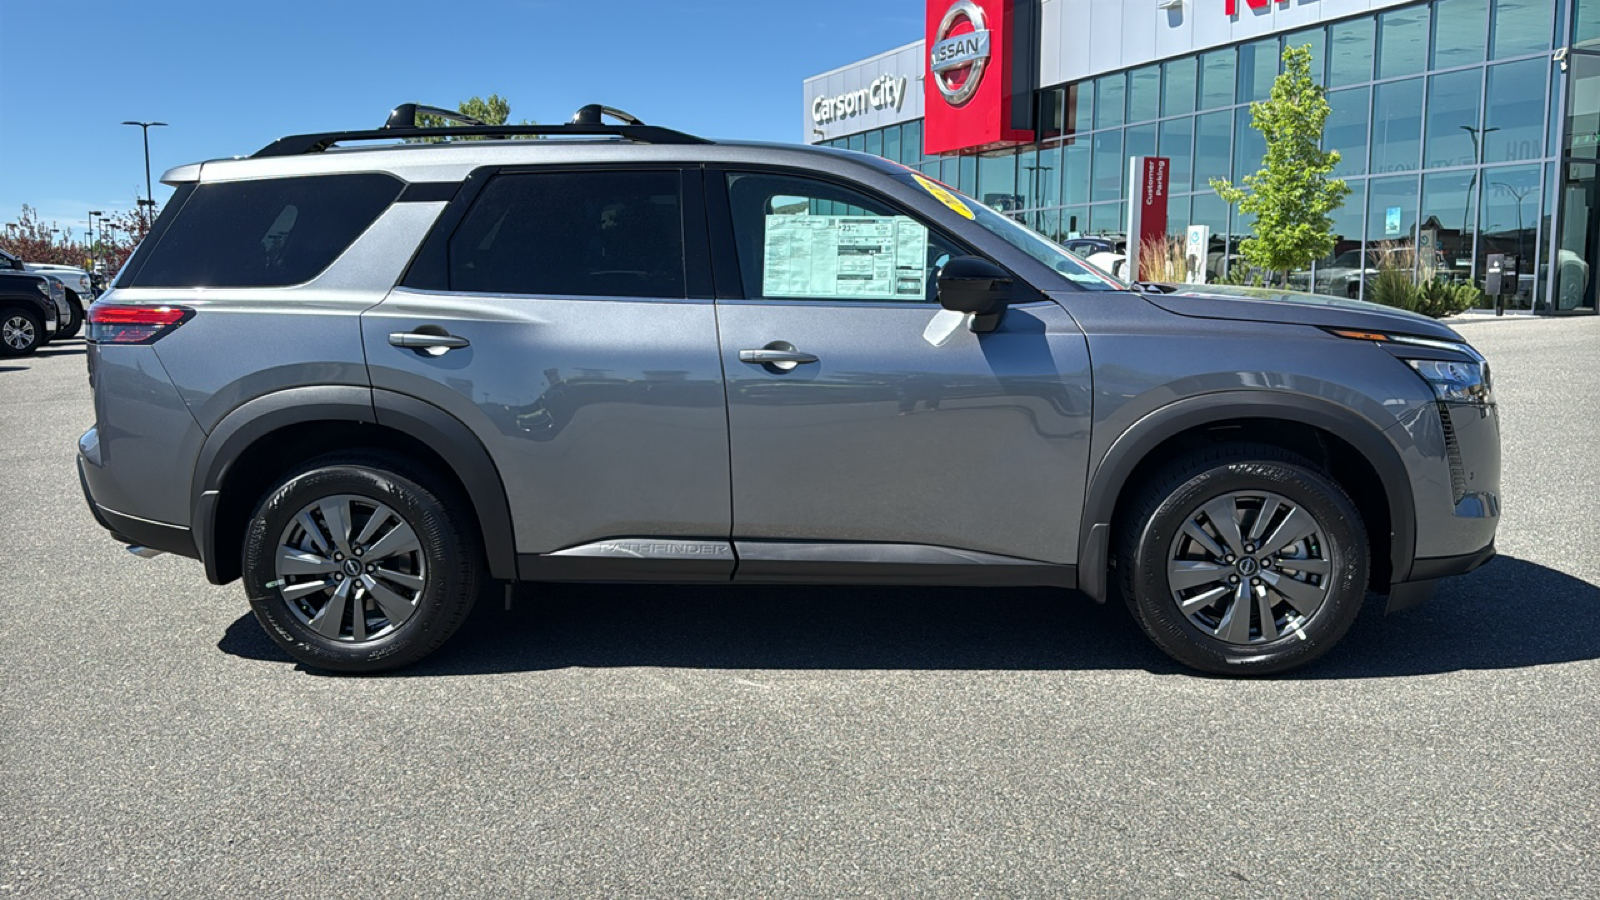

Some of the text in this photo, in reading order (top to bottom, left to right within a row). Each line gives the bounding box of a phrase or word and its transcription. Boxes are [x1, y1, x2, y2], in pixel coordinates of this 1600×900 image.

[812, 74, 907, 123] Carson City
[1146, 161, 1155, 205] Customer
[1156, 160, 1165, 196] Parking
[599, 543, 729, 555] PATHFINDER
